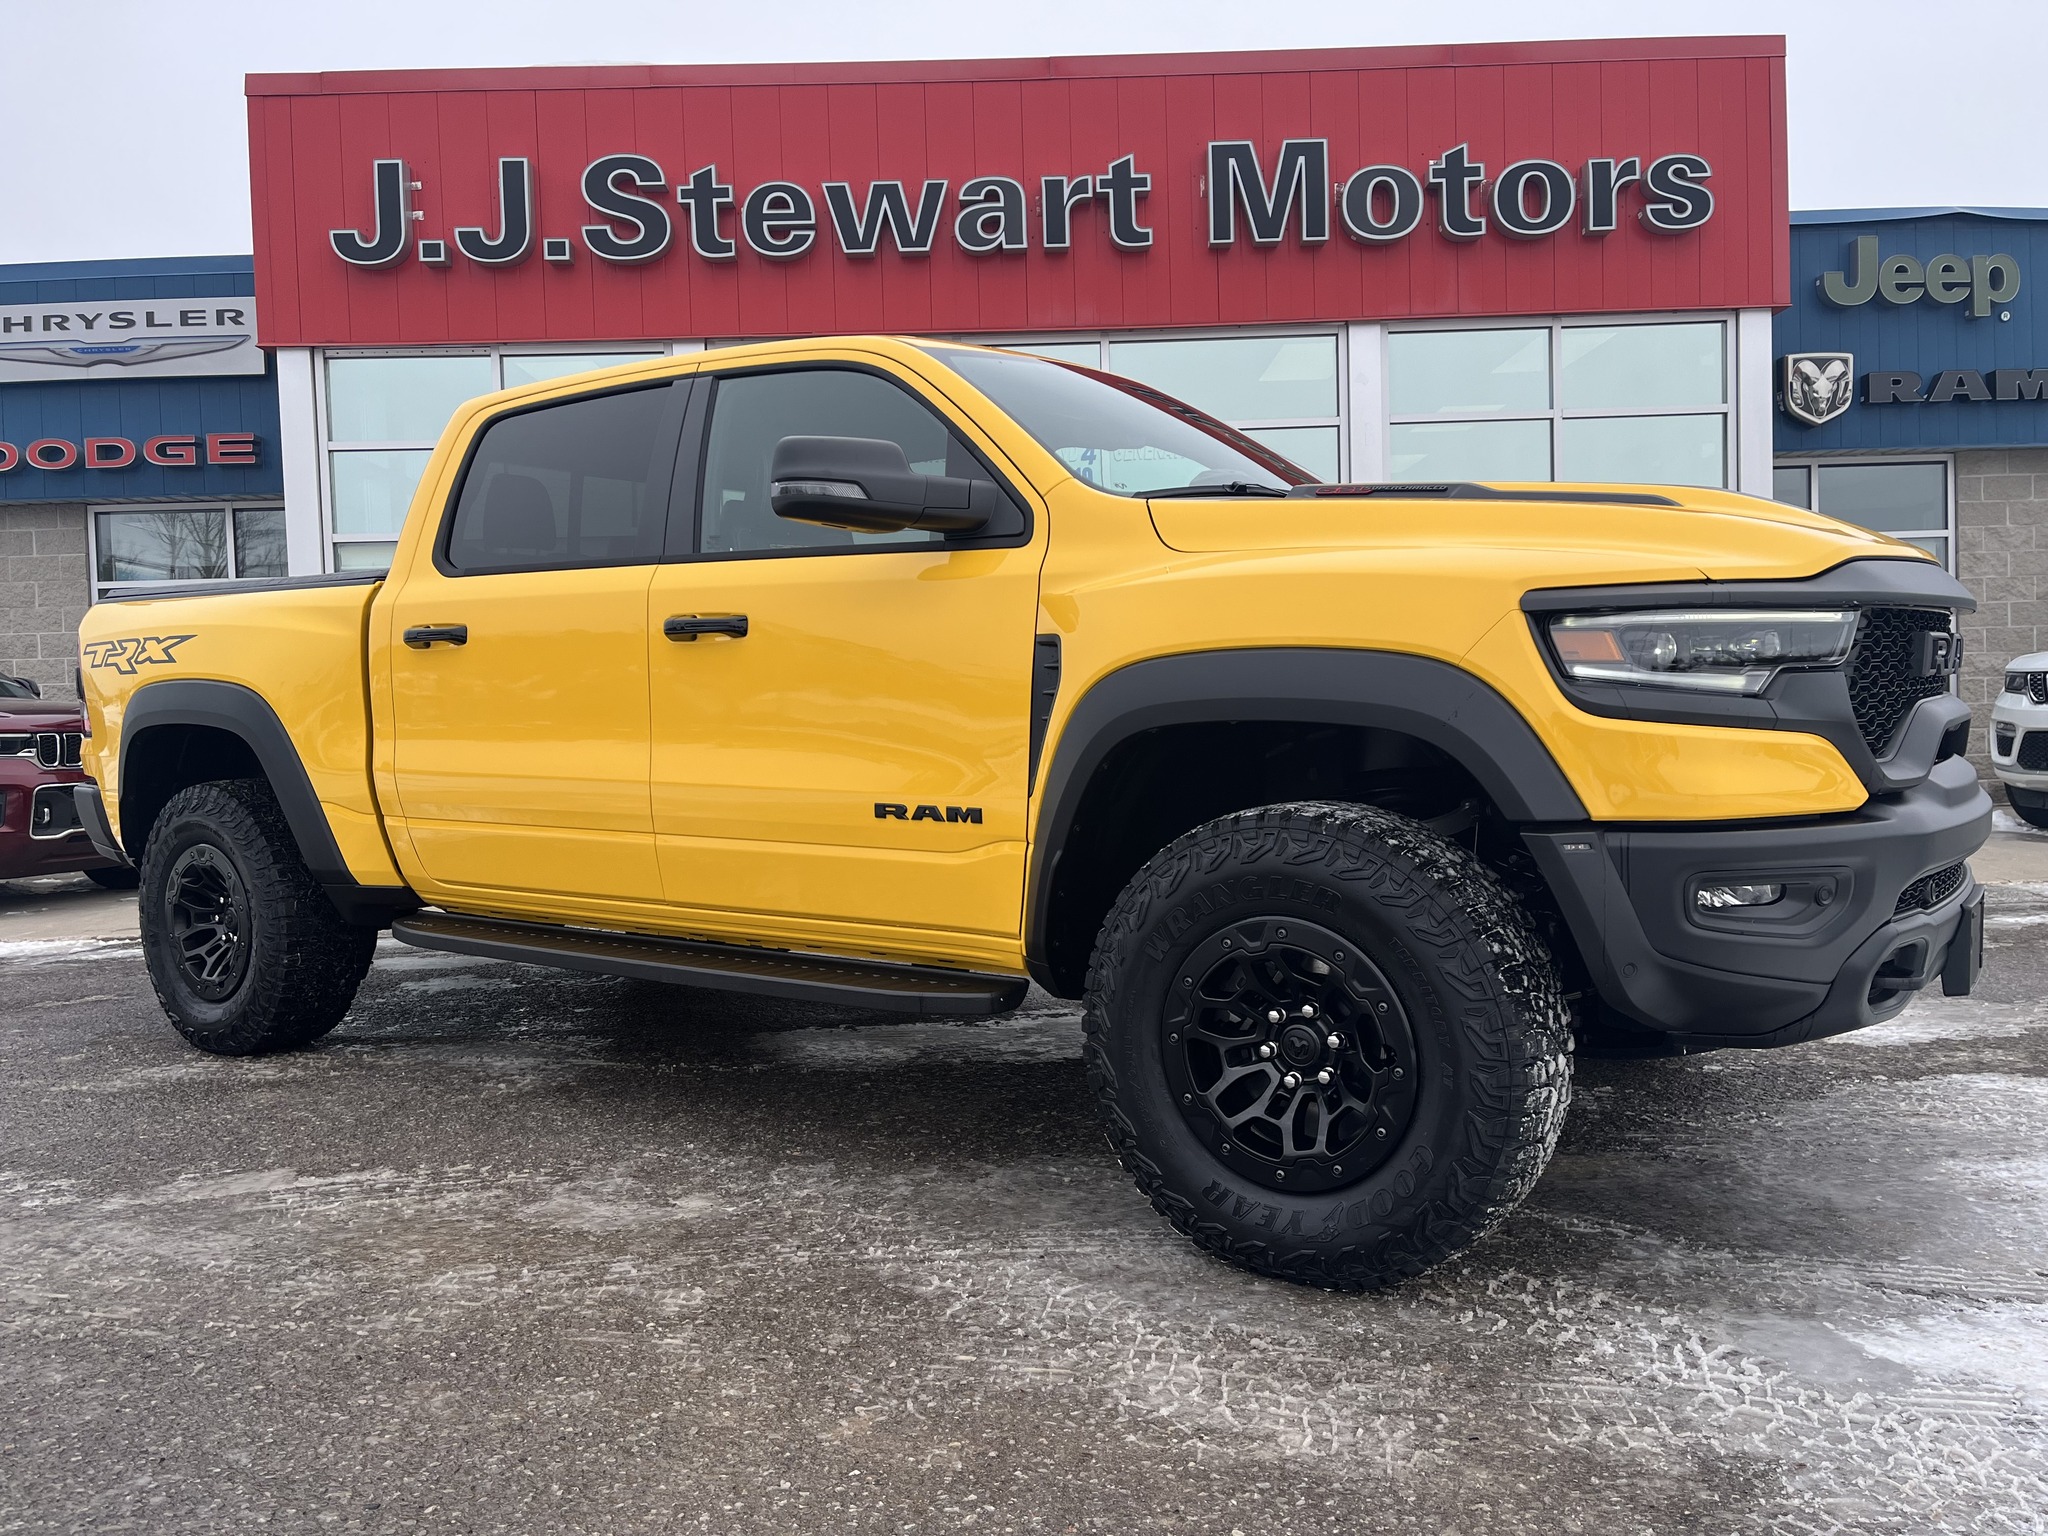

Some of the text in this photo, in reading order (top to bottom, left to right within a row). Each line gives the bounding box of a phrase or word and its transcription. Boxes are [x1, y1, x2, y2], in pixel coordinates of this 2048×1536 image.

[1207, 137, 1716, 247] Motors
[1820, 235, 2021, 317] Jeep
[1865, 368, 2048, 404] RAM
[83, 634, 198, 675] TRX
[874, 802, 983, 825] RAM
[1143, 875, 1343, 963] WRANGLER
[1388, 936, 1451, 1049] TERRITORY
